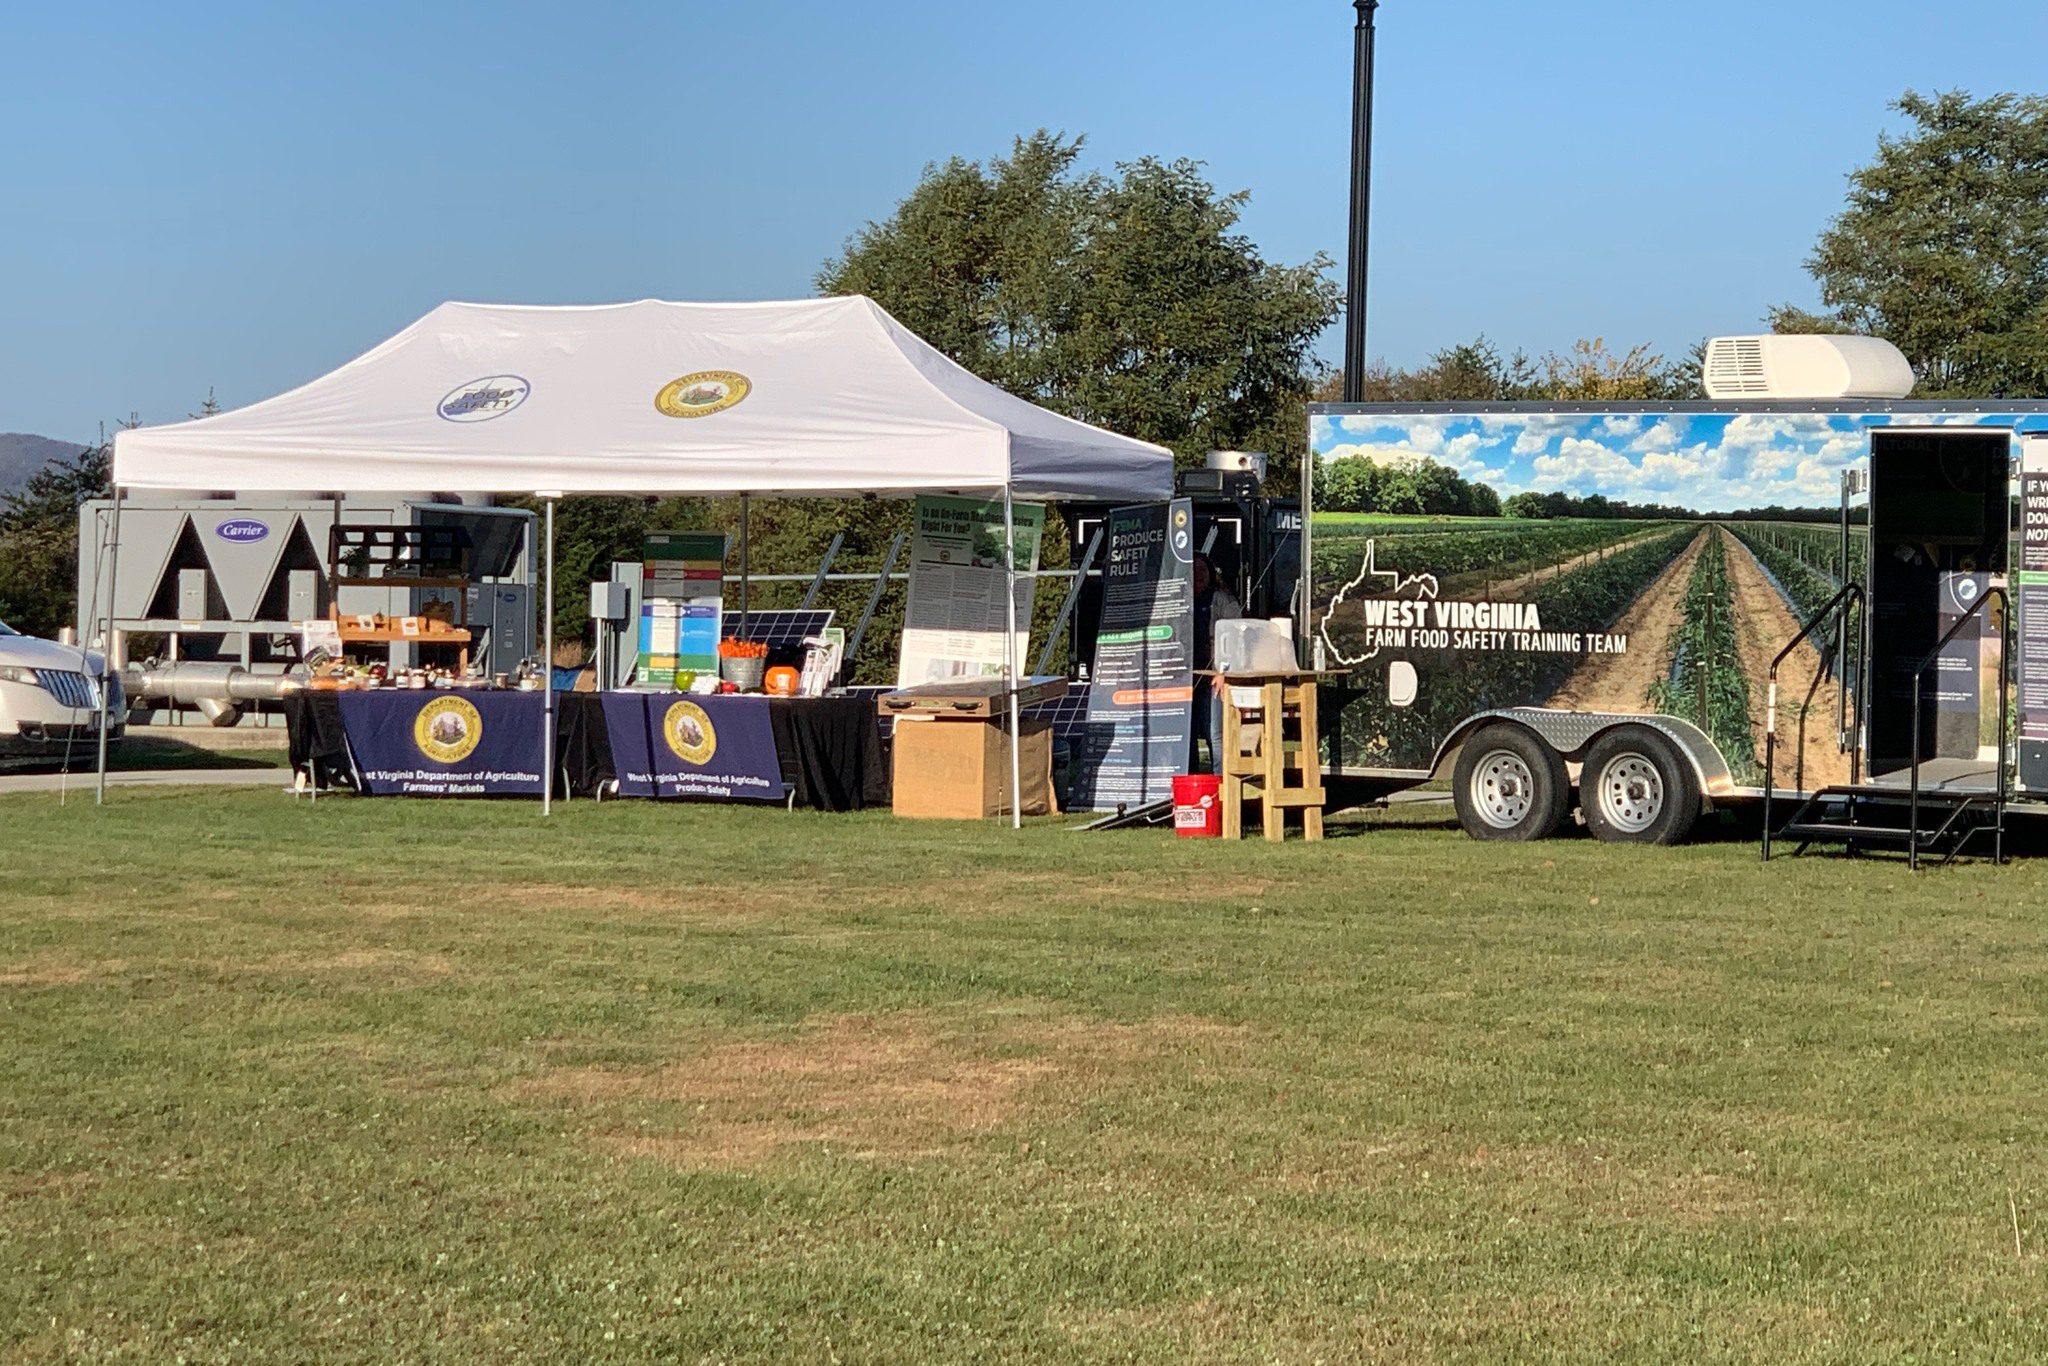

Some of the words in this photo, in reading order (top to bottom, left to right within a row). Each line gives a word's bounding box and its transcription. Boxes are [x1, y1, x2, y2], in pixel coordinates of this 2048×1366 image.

[2027, 480, 2038, 492] IF
[2040, 480, 2048, 492] Y
[223, 525, 263, 536] Carrier
[1112, 529, 1163, 548] PRODUCE
[1111, 545, 1150, 562] SAFETY
[1109, 562, 1138, 577] RULE
[1364, 600, 1429, 628] WEST
[1434, 602, 1541, 631] VIRGINIA
[1366, 628, 1406, 647] FARM
[1411, 629, 1449, 648] FOOD
[1453, 630, 1507, 650] SAFETY
[1512, 632, 1581, 653] TRAINING
[1586, 634, 1627, 653] TEAM
[378, 771, 414, 782] Virginia
[416, 770, 472, 781] Department
[474, 771, 484, 780] of
[485, 771, 540, 782] Agriculture
[627, 773, 647, 782] West
[646, 773, 678, 784] Vrginia
[730, 775, 770, 787] Agriculture
[448, 784, 486, 793] Markets
